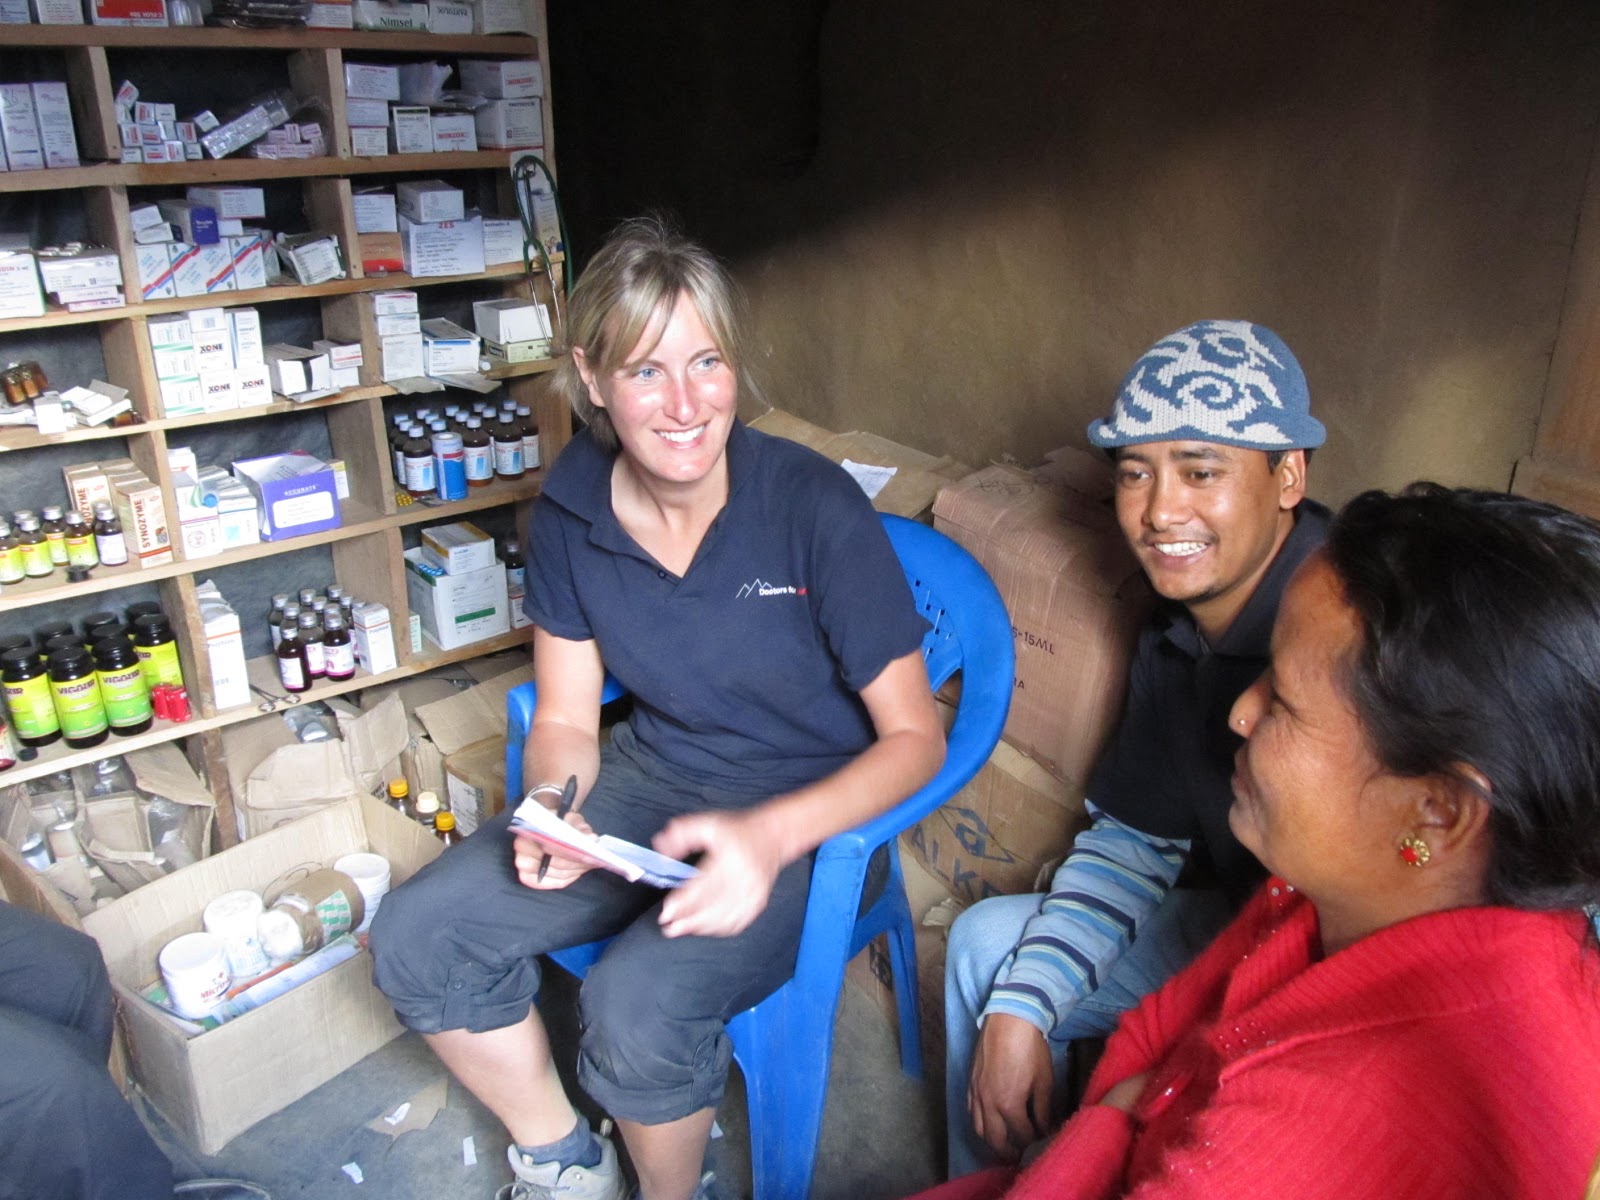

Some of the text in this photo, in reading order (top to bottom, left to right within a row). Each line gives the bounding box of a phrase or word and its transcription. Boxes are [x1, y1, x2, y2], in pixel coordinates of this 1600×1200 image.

[379, 17, 413, 27] Nimsel
[199, 343, 224, 354] XONE
[208, 383, 231, 394] XONE
[242, 379, 265, 390] XONE
[134, 499, 151, 549] SYNOZYME
[759, 586, 787, 596] Doctors
